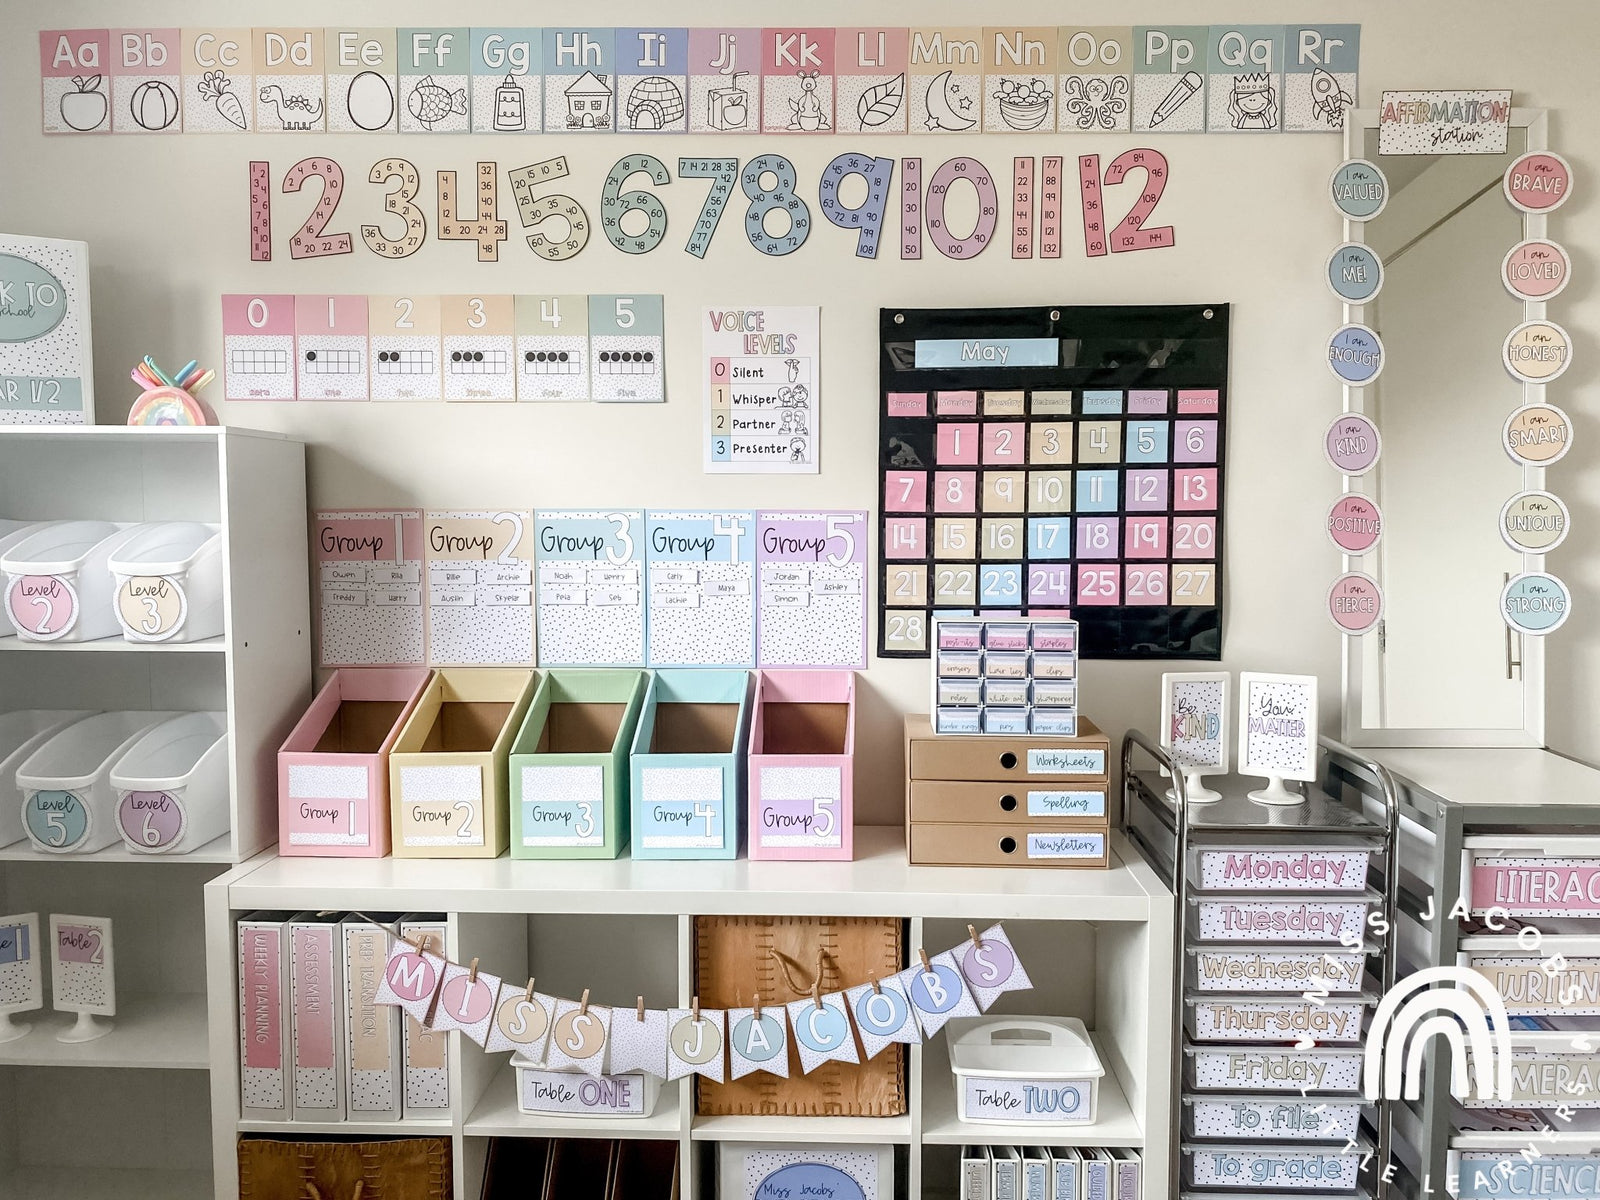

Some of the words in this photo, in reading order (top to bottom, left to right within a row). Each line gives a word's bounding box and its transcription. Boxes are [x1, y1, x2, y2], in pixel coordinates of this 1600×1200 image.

[52, 35, 100, 68] Aa
[121, 33, 167, 67] Bb
[265, 33, 312, 67] Dd
[339, 32, 383, 66] Ee
[482, 34, 530, 76] Gg
[555, 32, 602, 66] Hh
[774, 32, 823, 67] Kk
[994, 31, 1046, 66] Nn
[1067, 31, 1122, 66] Oo
[1145, 30, 1195, 73] Pp
[1217, 31, 1274, 73] Qq
[1297, 30, 1346, 66] Rr
[1381, 101, 1509, 125] AFFIRMATION
[1430, 126, 1485, 147] station
[480, 166, 491, 175] 32
[711, 162, 722, 171] 28
[1133, 153, 1145, 163] 84
[480, 181, 492, 190] 36
[1045, 176, 1057, 185] 88
[1333, 183, 1383, 201] VALUED
[1512, 173, 1562, 195] BRAVE
[282, 157, 352, 260] 2
[508, 156, 590, 261] 5
[547, 200, 559, 209] 35
[601, 154, 671, 255] 6
[636, 196, 648, 205] 66
[679, 157, 738, 259] 7
[706, 209, 717, 218] 63
[900, 157, 998, 260] 10
[1079, 148, 1175, 257] 12
[905, 245, 917, 254] 50
[948, 245, 962, 254] 100
[1342, 265, 1367, 284] ME!
[1511, 262, 1561, 281] LOVED
[25, 282, 58, 307] TO
[247, 298, 269, 328] 0
[466, 298, 487, 329] 3
[615, 298, 636, 329] 5
[709, 310, 765, 332] VOICE
[743, 333, 798, 354] LEVELS
[961, 341, 1010, 365] May
[1509, 345, 1566, 362] HONEST
[715, 362, 726, 376] 0
[732, 367, 764, 378] Silent
[1329, 346, 1380, 368] ENOUGH
[718, 388, 723, 403] 1
[732, 394, 777, 407] Whisper
[717, 415, 725, 429] 2
[733, 419, 776, 429] Partner
[717, 440, 726, 455] 3
[733, 443, 788, 454] Presenter
[995, 429, 1012, 456] 2
[1089, 427, 1109, 454] 4
[1335, 436, 1368, 457] KIND
[1509, 424, 1567, 448] SMART
[994, 476, 1013, 502] 9
[1183, 475, 1208, 501] 13
[990, 523, 1015, 549] 16
[1175, 522, 1213, 549] 20
[1329, 516, 1380, 536] POSITIVE
[1506, 515, 1562, 531] UNIQUE
[430, 526, 493, 560] Group
[492, 511, 524, 565] 2
[541, 526, 604, 560] Group
[605, 513, 634, 566] 3
[763, 527, 826, 562] Group
[826, 515, 855, 568] 5
[332, 571, 356, 579] Owen
[554, 572, 573, 580] Noah
[774, 573, 800, 581] Jordan
[824, 583, 848, 591] Ashley
[983, 570, 1018, 596] 23
[1080, 570, 1117, 596] 25
[20, 580, 61, 598] Level
[129, 580, 169, 598] Level
[718, 584, 735, 593] Maya
[774, 594, 799, 602] Simon
[31, 596, 54, 634] 2
[140, 596, 162, 635] 3
[1335, 597, 1374, 614] FIERCE
[1506, 597, 1565, 614] STRONG
[887, 615, 922, 641] 28
[1178, 697, 1197, 714] Be
[1260, 696, 1295, 717] You
[1170, 712, 1220, 742] KIND
[1248, 717, 1306, 738] MATTER
[1036, 754, 1096, 769] Worksheets
[36, 794, 75, 813] Level
[131, 794, 170, 812] Level
[1043, 796, 1090, 811] Spelling
[46, 812, 67, 847] 5
[141, 811, 161, 846] 6
[300, 802, 339, 824] Group
[348, 800, 356, 836] 1
[653, 805, 693, 826] Group
[693, 802, 717, 837] 4
[1034, 838, 1097, 852] Newsletters
[1224, 854, 1347, 885] Monday
[1221, 906, 1344, 936] Tuesday
[58, 930, 92, 950] Table
[359, 935, 374, 962] PREP
[254, 933, 268, 980] WEEKLY
[1202, 955, 1360, 984] Wednesday
[304, 933, 320, 1016] ASSESSMENT
[255, 984, 270, 1044] PLANNING
[360, 965, 377, 1038] TRANSITION
[1210, 1006, 1348, 1036] Thursday
[1229, 1054, 1327, 1087] Friday
[531, 1081, 576, 1103] Table
[578, 1079, 631, 1108] ONE
[975, 1089, 1022, 1110] Table
[1022, 1085, 1081, 1113] TWO
[1231, 1105, 1261, 1129] To
[1211, 1153, 1241, 1176] To
[1250, 1155, 1342, 1182] grade
[764, 1184, 792, 1197] Miss
